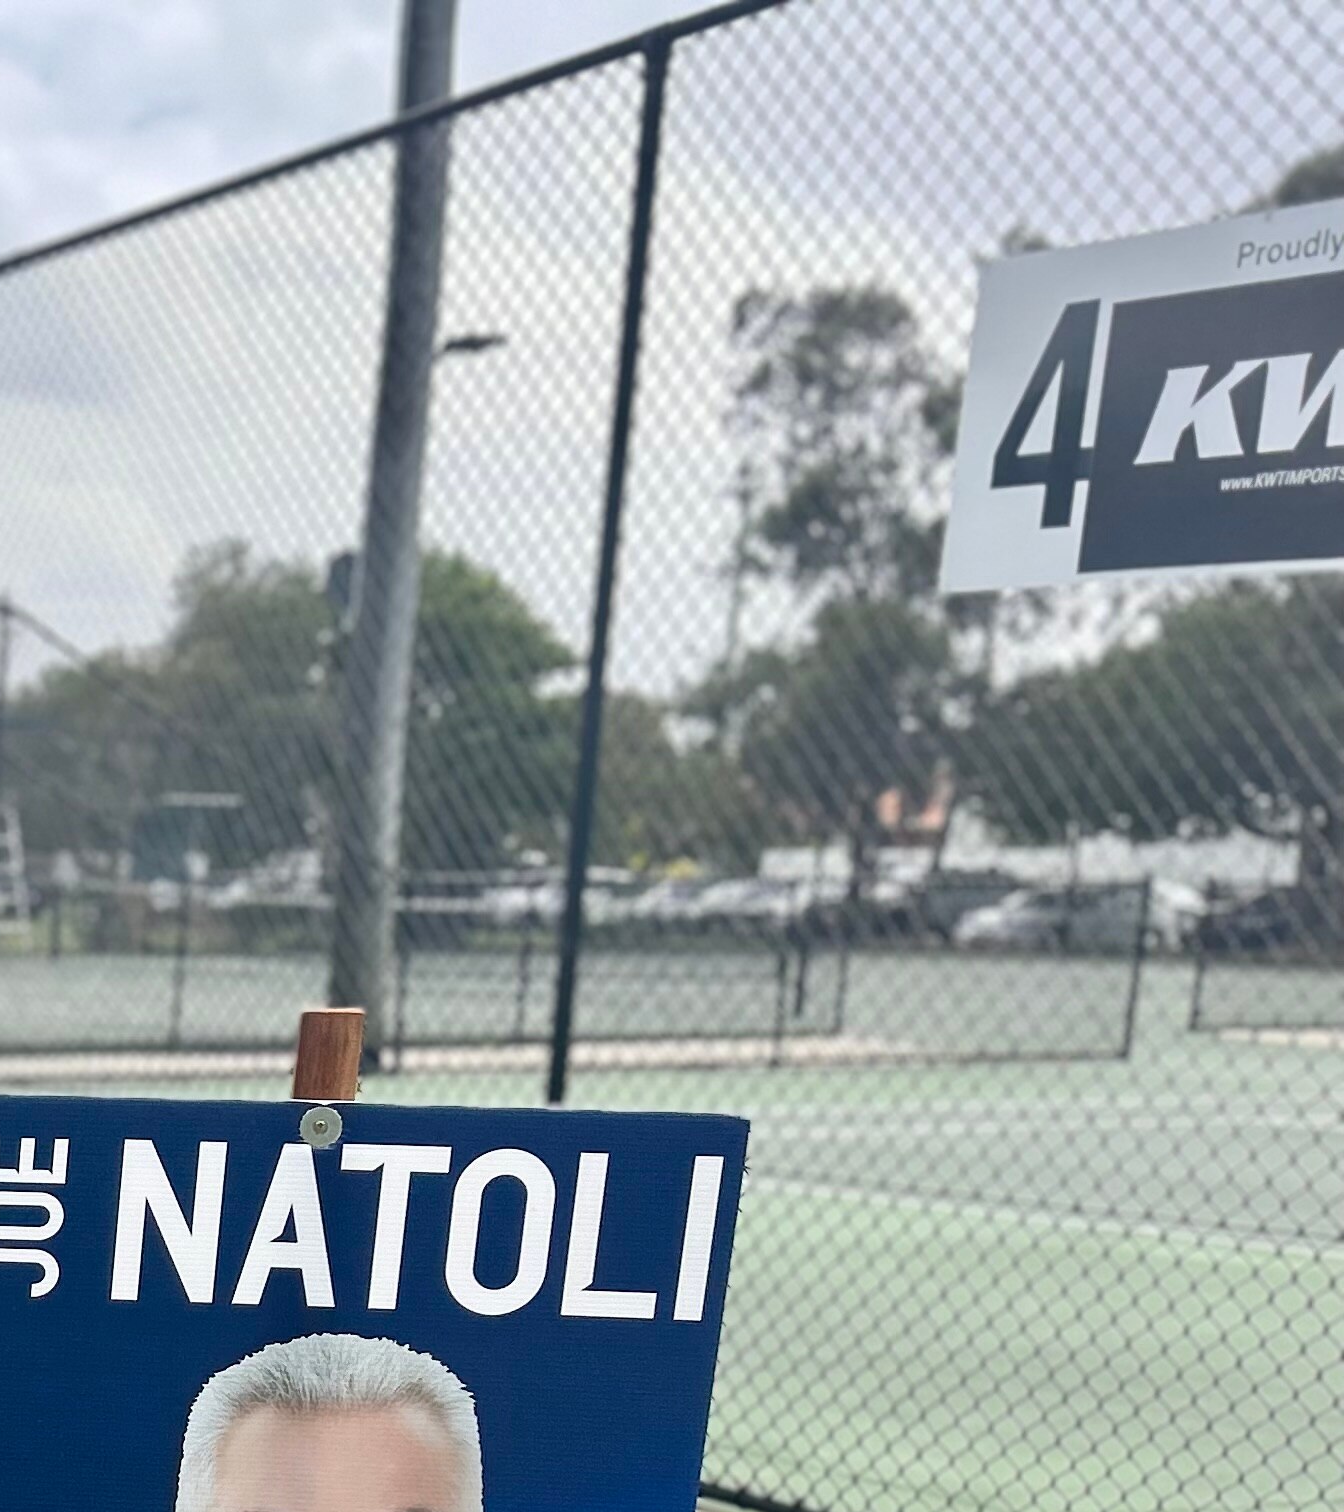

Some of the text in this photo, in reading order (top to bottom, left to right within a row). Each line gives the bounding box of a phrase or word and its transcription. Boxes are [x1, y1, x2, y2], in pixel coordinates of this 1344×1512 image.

[1236, 227, 1344, 269] Proudly
[989, 298, 1101, 530] 4
[110, 1137, 724, 1323] NATOLI
